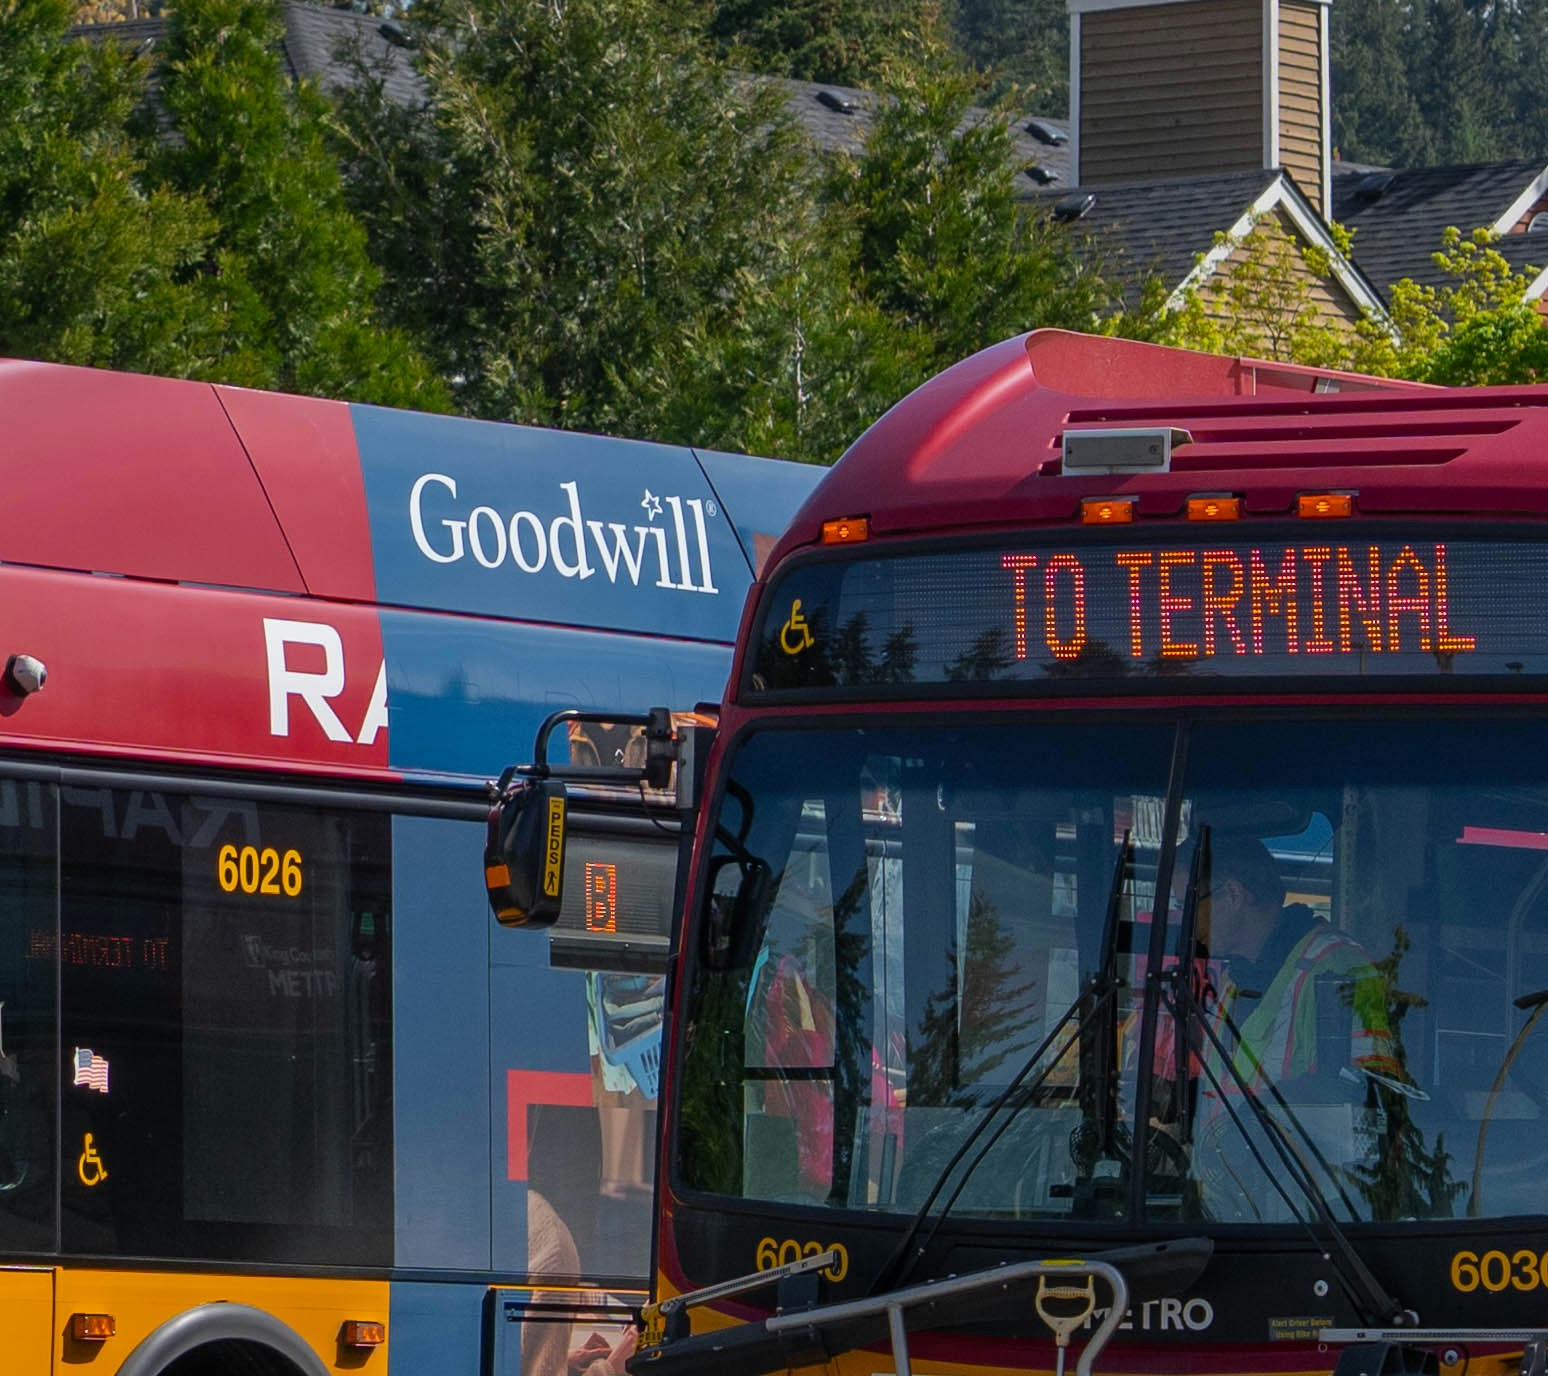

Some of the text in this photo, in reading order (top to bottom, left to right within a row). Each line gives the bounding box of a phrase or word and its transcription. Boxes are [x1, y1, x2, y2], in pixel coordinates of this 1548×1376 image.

[409, 473, 719, 594] Goodwill
[1001, 544, 1477, 659] TO TERMINAL
[217, 844, 303, 897] 6026
